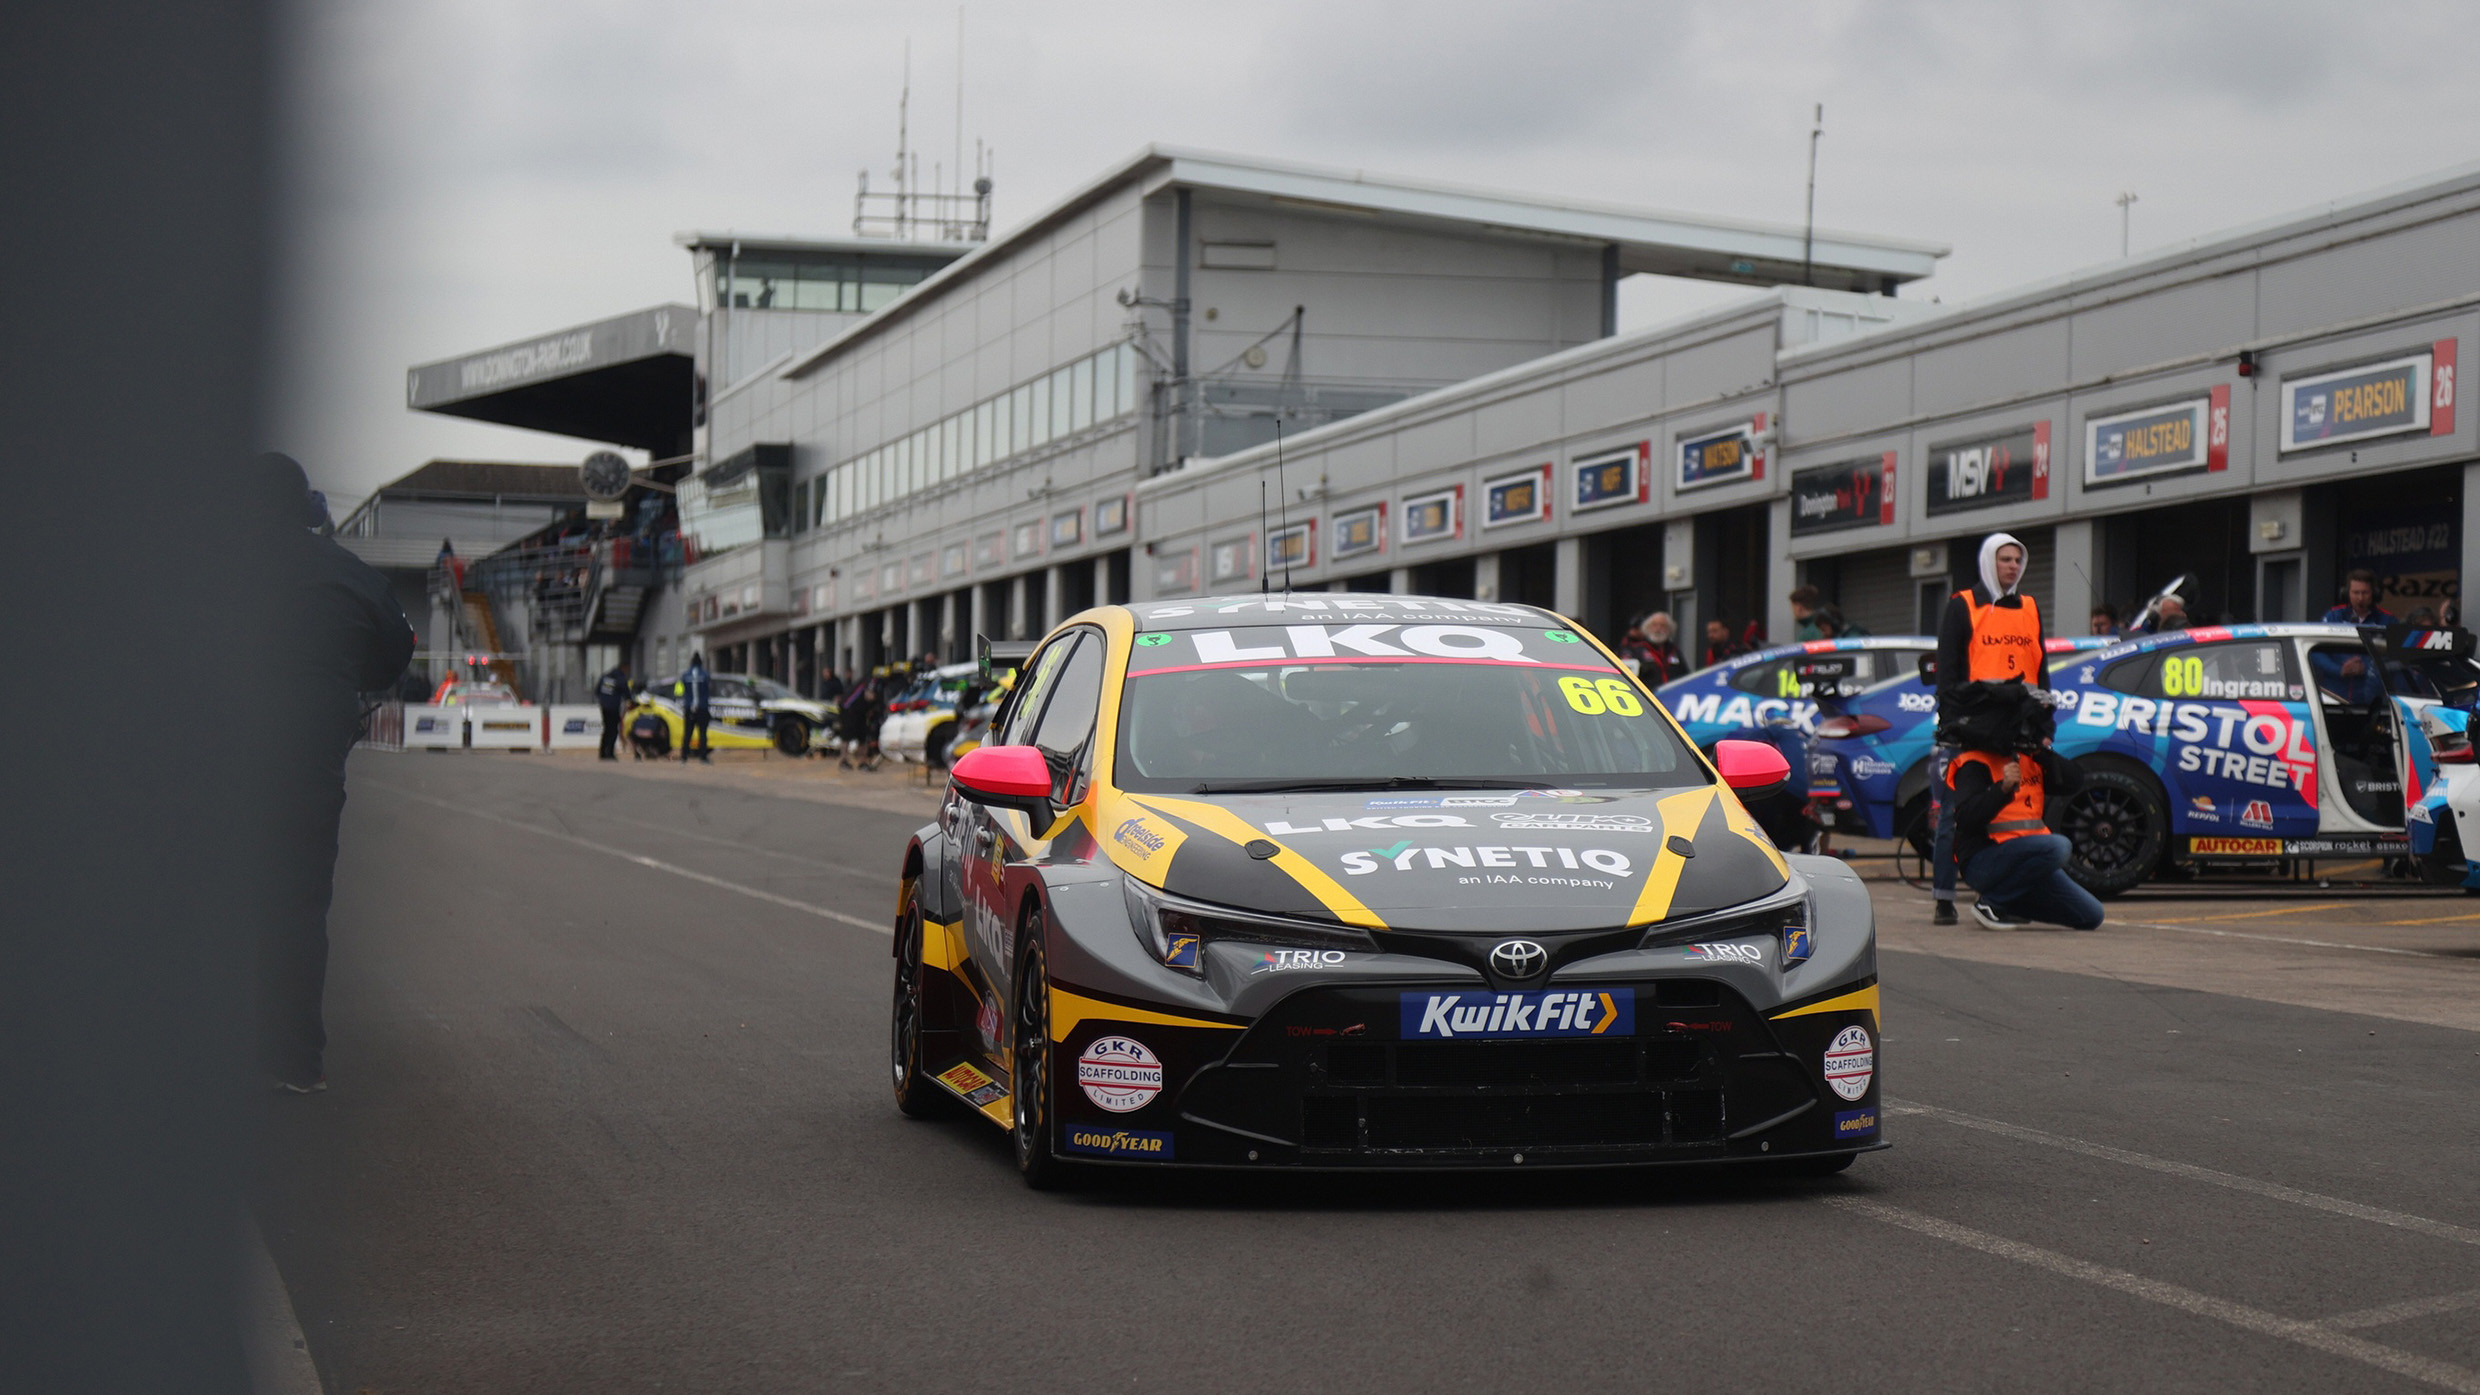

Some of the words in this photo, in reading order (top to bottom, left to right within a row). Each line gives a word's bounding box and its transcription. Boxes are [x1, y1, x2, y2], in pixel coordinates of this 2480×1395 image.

[2436, 366, 2453, 409] 26
[2333, 378, 2406, 423] PEARSON
[2213, 406, 2228, 446] 25
[2126, 419, 2191, 460] HALSTEAD
[2035, 443, 2048, 478] 24
[1947, 446, 1992, 500] MSV
[1884, 471, 1895, 503] 23
[1148, 600, 1539, 619] SYNETIQ
[1301, 613, 1333, 621] an
[1343, 611, 1388, 620] IAA
[1402, 612, 1522, 624] company
[1190, 624, 1542, 664] LKQ
[2008, 653, 2015, 670] 5
[1777, 669, 1800, 698] 14
[2163, 656, 2203, 697] 80
[2203, 676, 2285, 699] Ingram
[1558, 676, 1643, 717] 66
[1676, 693, 1820, 735] MACK
[2077, 691, 2316, 764] BRISTOL
[2178, 745, 2312, 791] STREET
[1264, 814, 1477, 836] LKQ
[2188, 809, 2220, 822] REPSOL
[1571, 824, 1648, 832] PARTS
[1119, 834, 1152, 861] ENGINEERING
[2196, 838, 2278, 853] AUTOCAR
[2334, 840, 2371, 850] rocket
[1340, 840, 1634, 878] SYNETIQ
[1458, 876, 1481, 885] an
[1486, 874, 1523, 884] IAA
[1527, 875, 1614, 890] company
[1275, 950, 1346, 964] TRIO
[1695, 943, 1762, 961] TRIO
[1701, 953, 1751, 965] LEASING
[1269, 961, 1323, 973] LEASING
[1286, 1026, 1313, 1038] TOW
[1709, 1021, 1732, 1031] TOW
[1839, 1029, 1867, 1047] GKR
[1094, 1041, 1143, 1061] GKR
[1825, 1055, 1873, 1072] SCAFFOLDING
[1079, 1065, 1161, 1083] SCAFFOLDING
[1837, 1079, 1867, 1095] LIMITED
[1092, 1089, 1145, 1107] LIMITED
[1839, 1113, 1875, 1132] GOODYEAR
[1073, 1131, 1163, 1152] GOODYEAR
